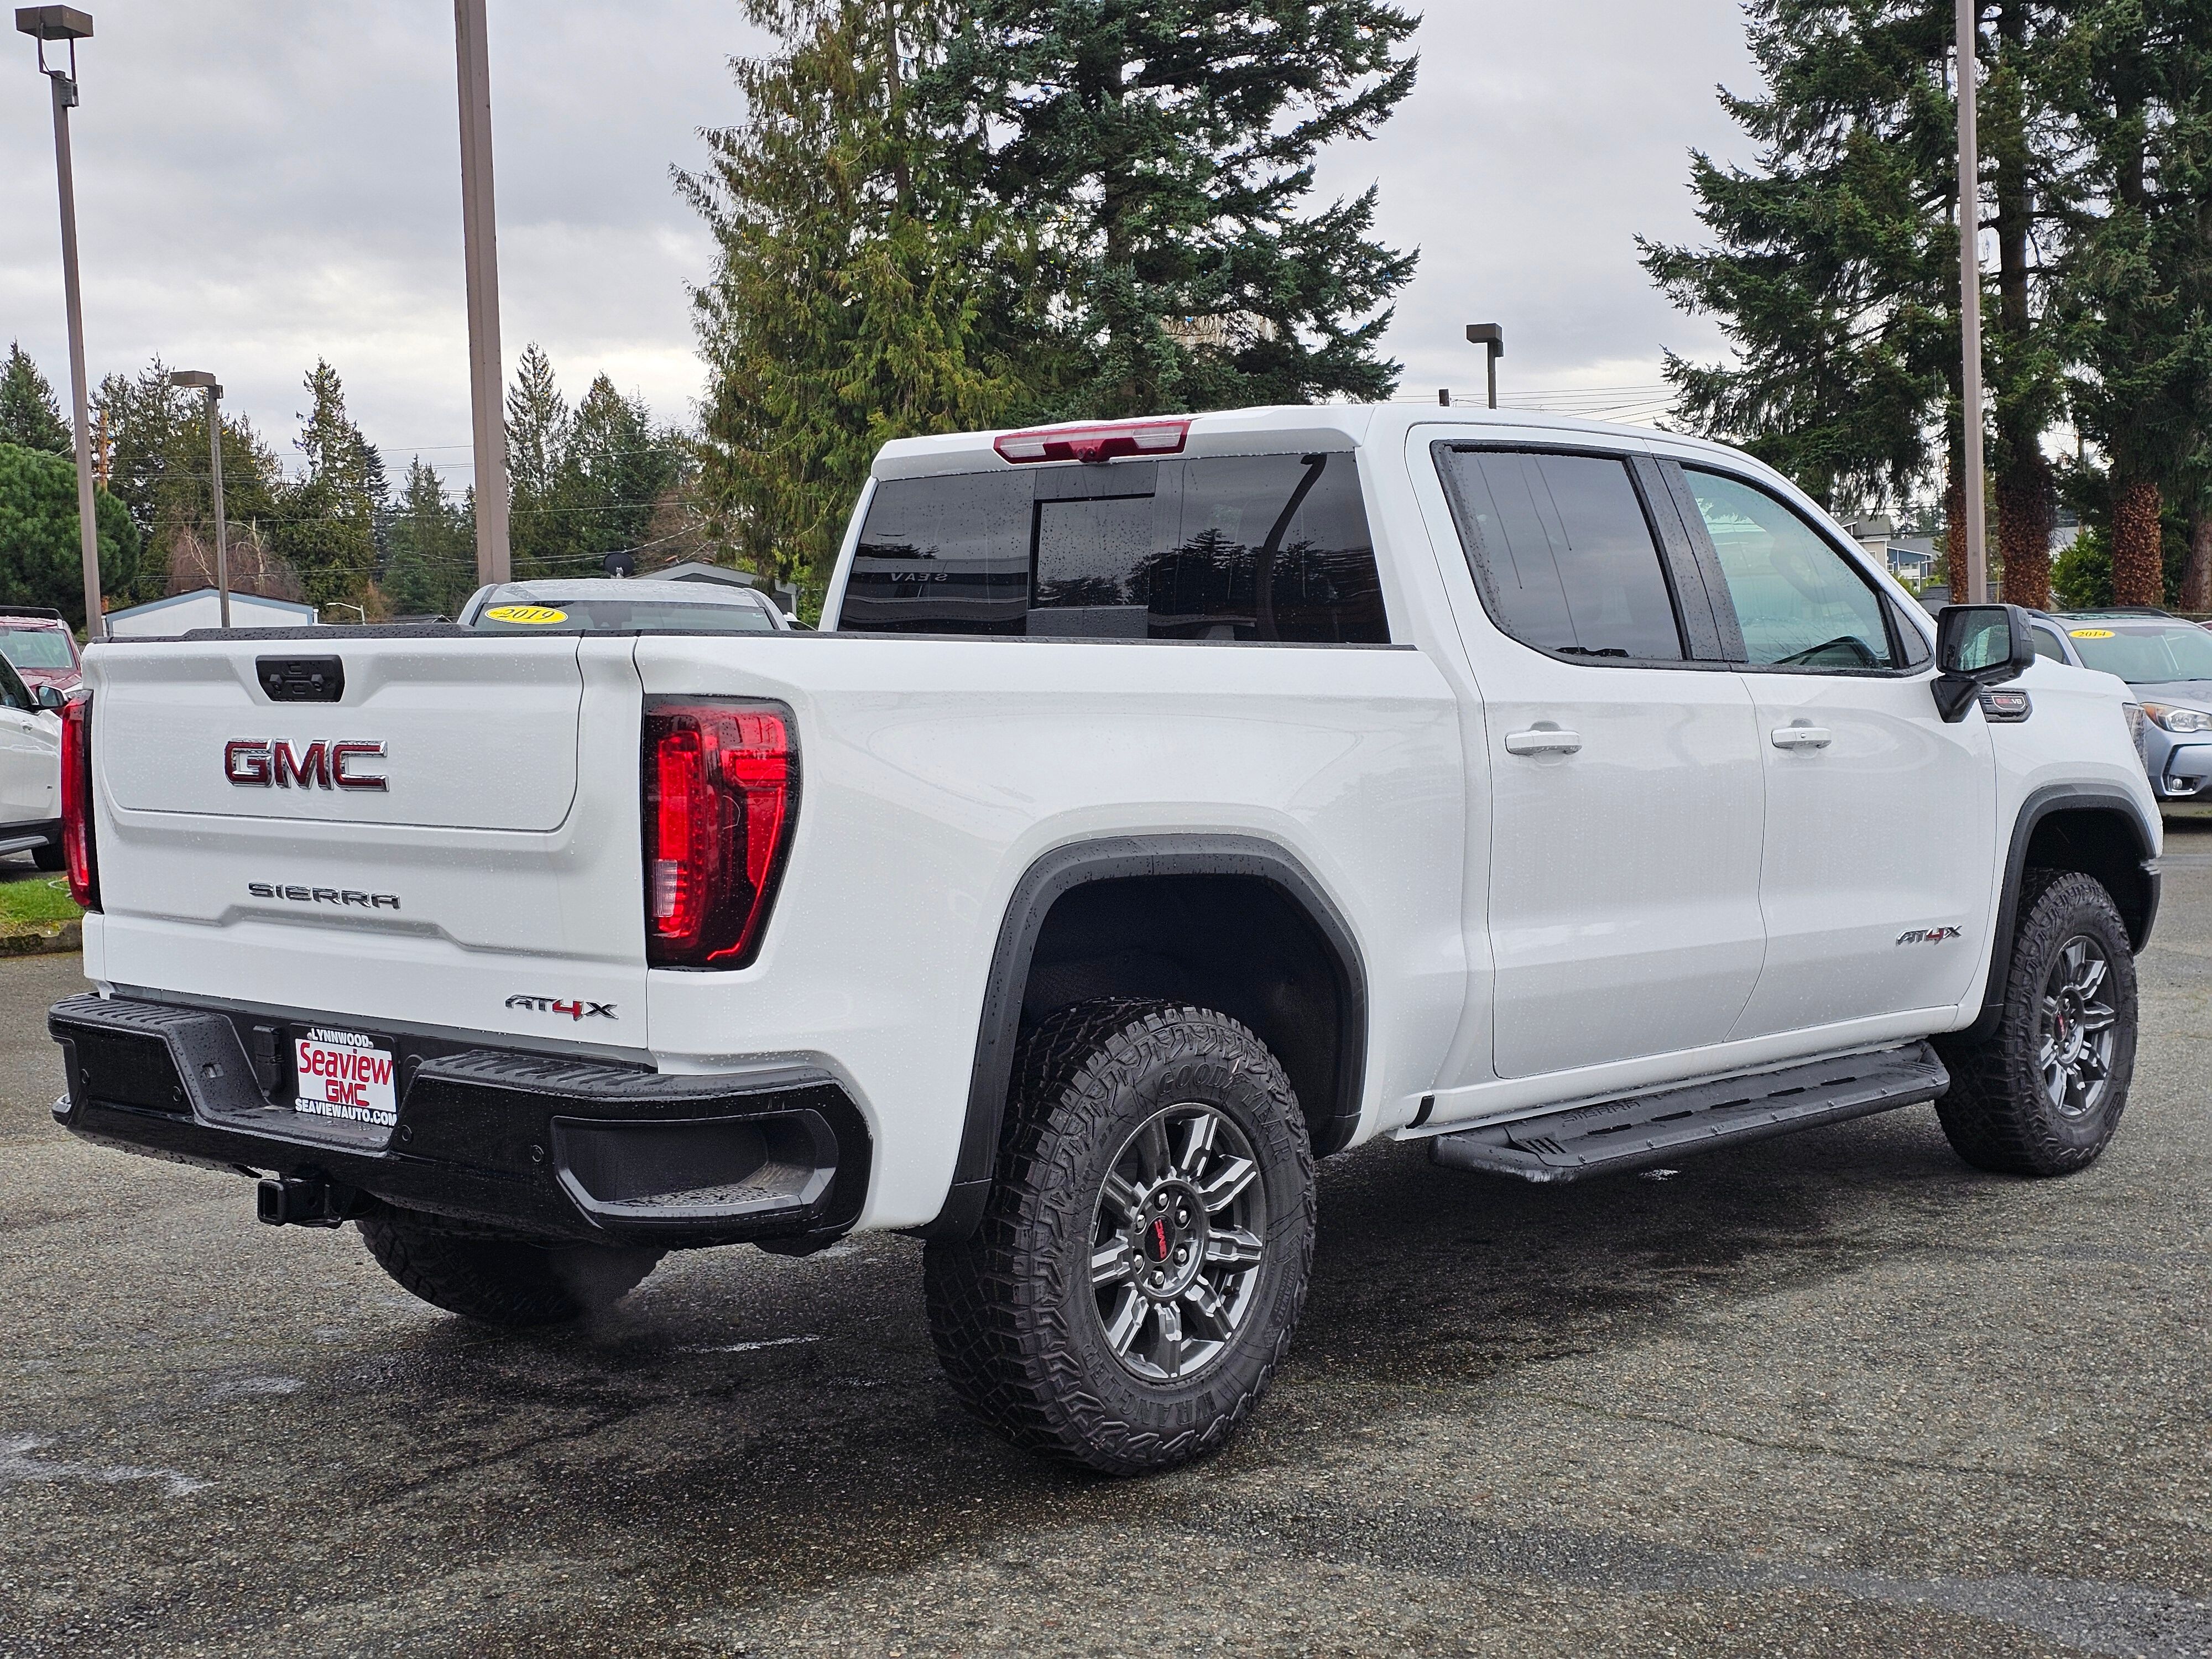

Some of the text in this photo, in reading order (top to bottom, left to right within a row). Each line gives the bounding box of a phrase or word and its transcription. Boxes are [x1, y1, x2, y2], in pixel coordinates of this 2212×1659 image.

[497, 609, 555, 620] 2019
[224, 738, 389, 792] GMC
[248, 881, 401, 910] SIERRA
[1896, 924, 1962, 947] AT4X
[505, 994, 619, 1022] AT4X
[311, 1028, 369, 1047] LYNNWOOD
[299, 1042, 393, 1085] Seaview
[325, 1079, 370, 1107] GMC
[295, 1098, 397, 1126] SEAVIEWAUTO.COM
[1154, 1219, 1167, 1259] GMC
[1082, 1341, 1217, 1427] WRANGLER
